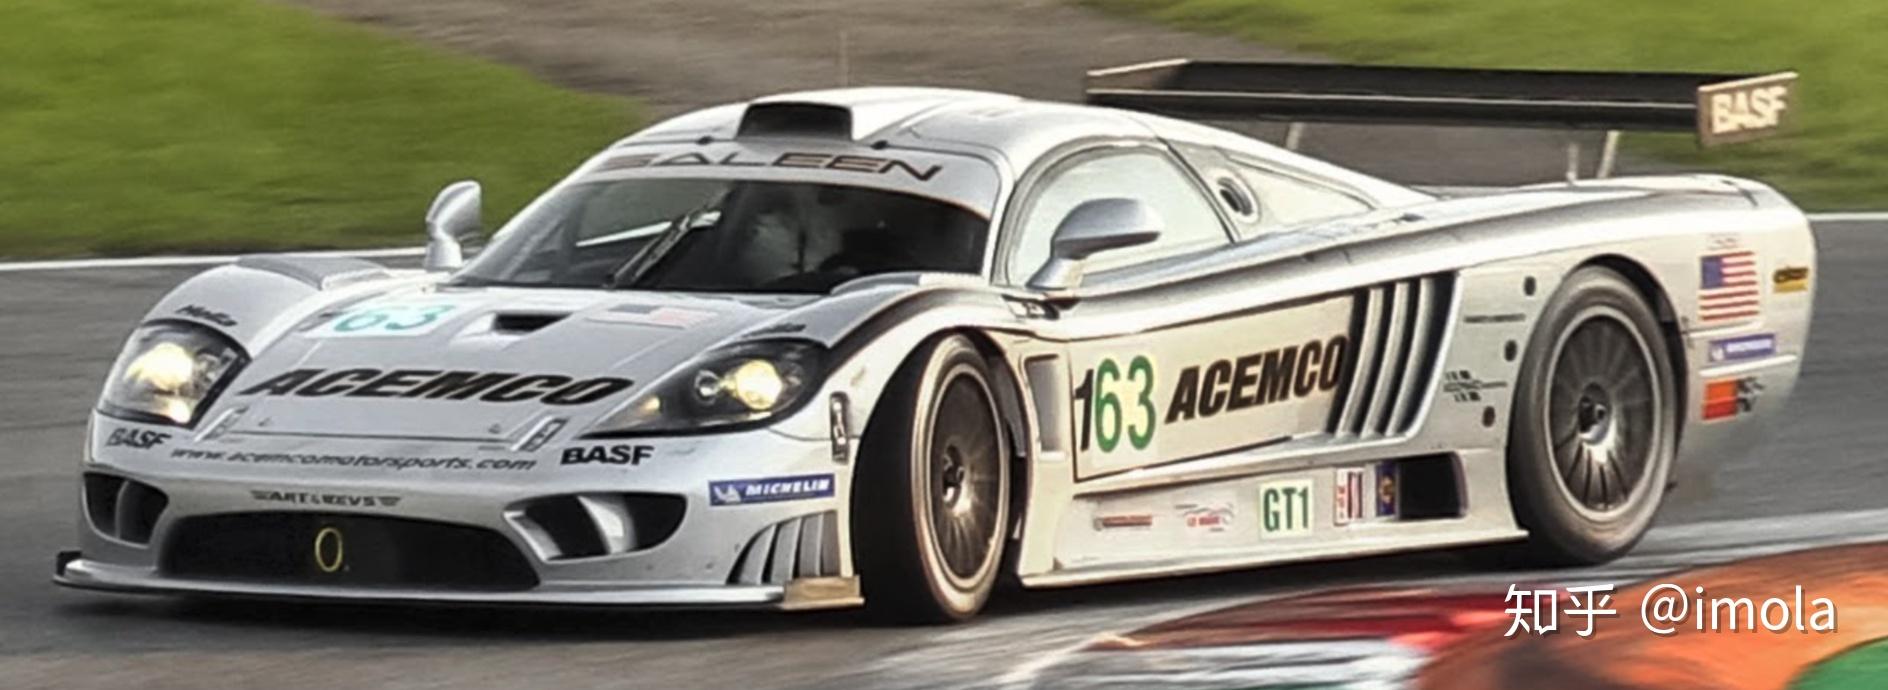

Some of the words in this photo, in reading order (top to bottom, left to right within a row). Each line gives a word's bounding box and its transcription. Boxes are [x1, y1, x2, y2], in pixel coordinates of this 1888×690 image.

[1711, 86, 1787, 133] BASF
[601, 151, 943, 181] SALEEN
[238, 368, 635, 405] ACEMCO
[1164, 335, 1348, 424] ACEMCO
[1074, 355, 1157, 453] 163
[104, 427, 172, 449] BASF
[560, 446, 654, 466] BASF
[745, 478, 831, 497] MICHELIN
[1263, 486, 1309, 532] GT1
